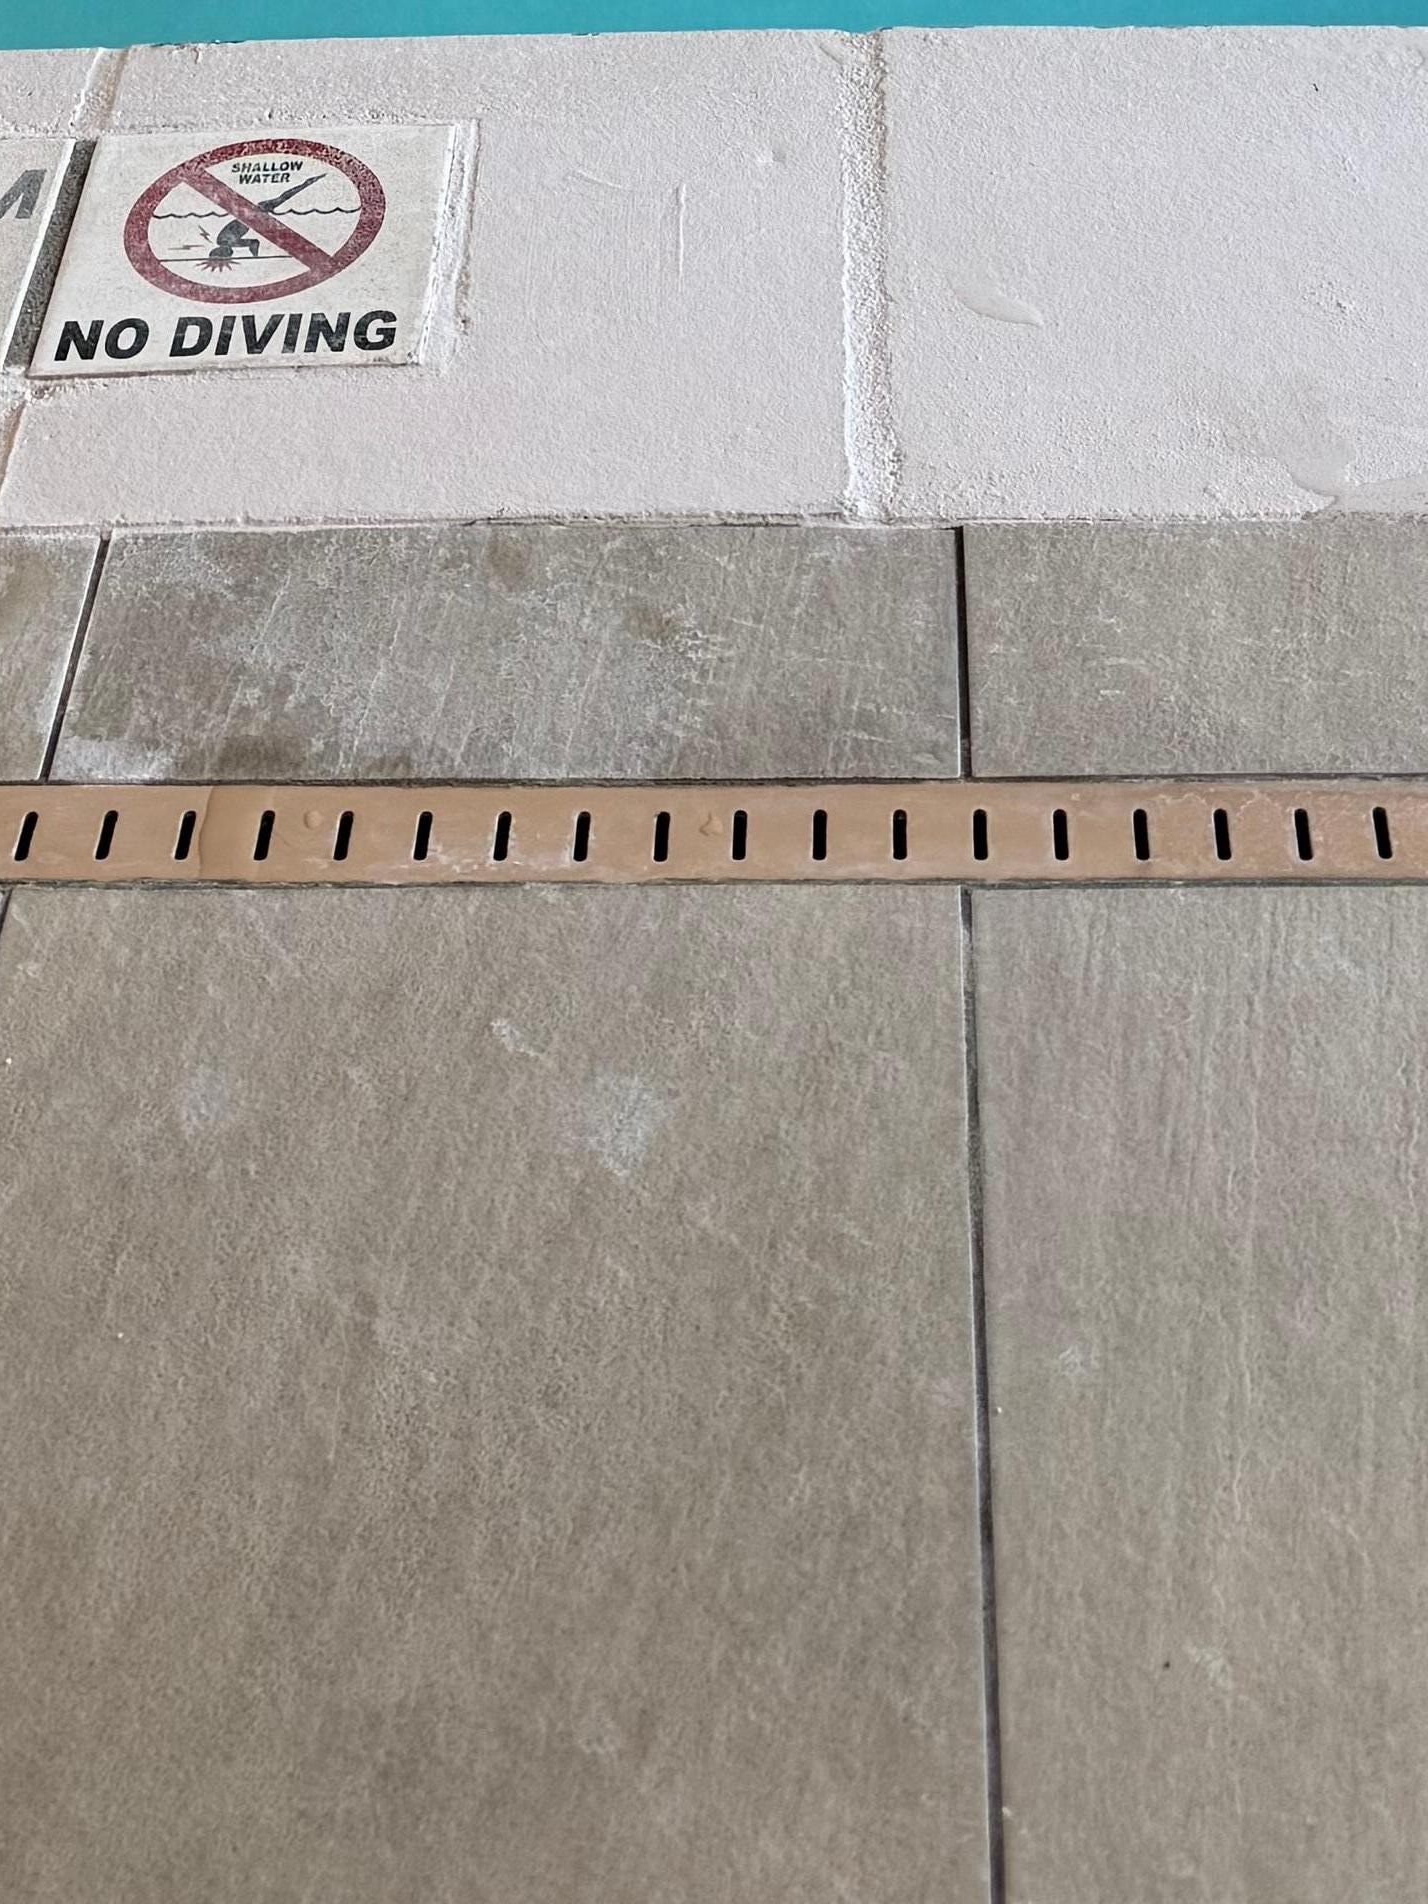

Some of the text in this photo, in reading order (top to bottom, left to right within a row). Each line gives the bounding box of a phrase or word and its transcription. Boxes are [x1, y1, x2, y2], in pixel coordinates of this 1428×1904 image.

[231, 161, 303, 173] SHALLOW
[239, 172, 290, 184] WATER
[53, 308, 399, 361] NO DIVING
